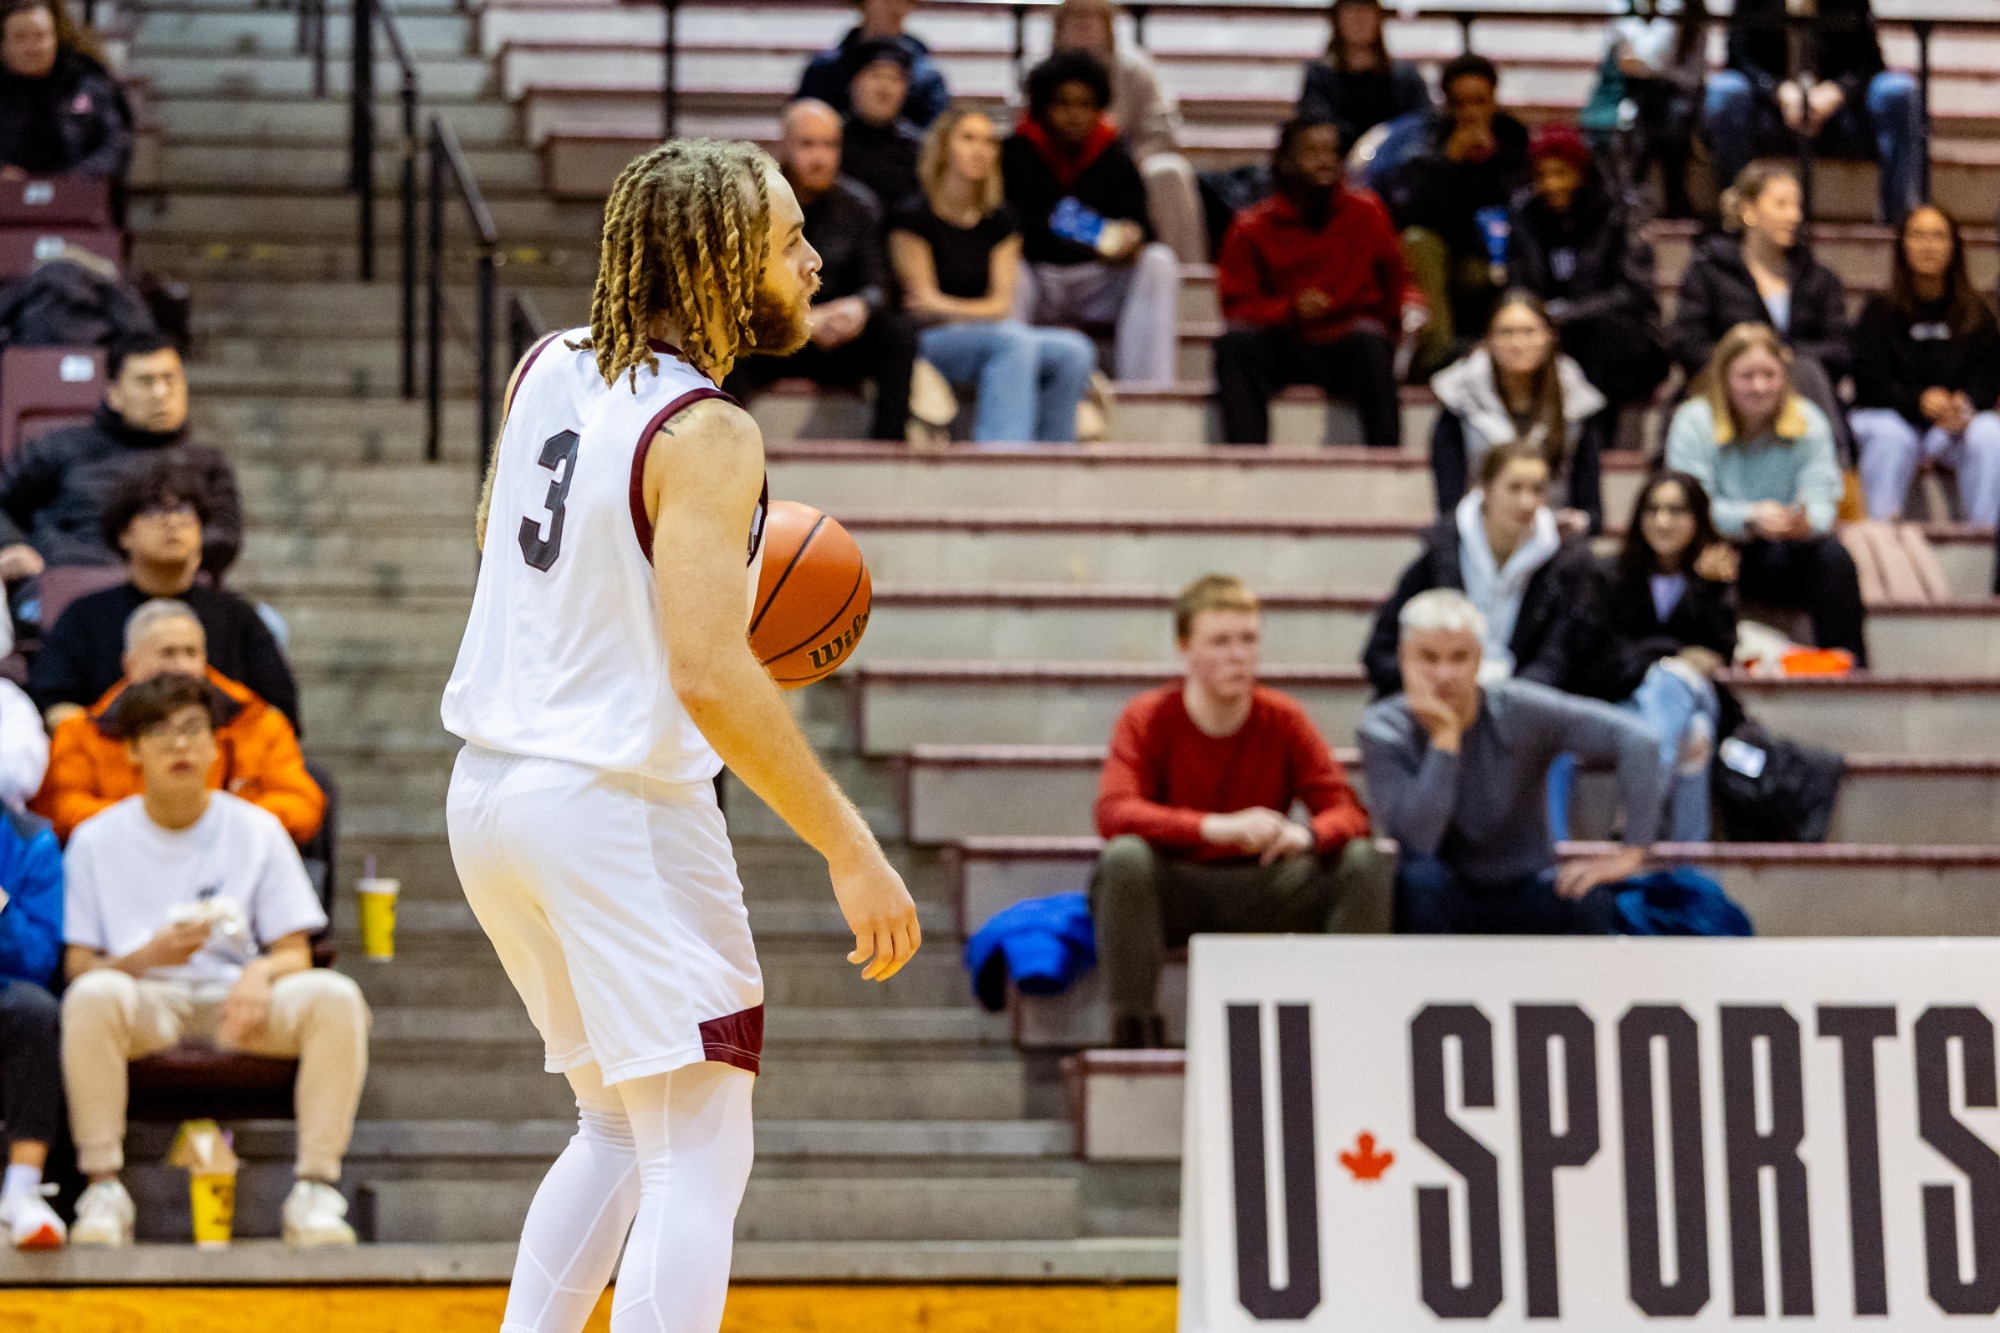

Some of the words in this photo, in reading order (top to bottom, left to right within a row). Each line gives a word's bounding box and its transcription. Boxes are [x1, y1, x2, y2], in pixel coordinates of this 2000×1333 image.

[518, 429, 580, 573] 3
[1227, 1004, 1321, 1319] U
[1411, 1003, 2000, 1319] SPORTS
